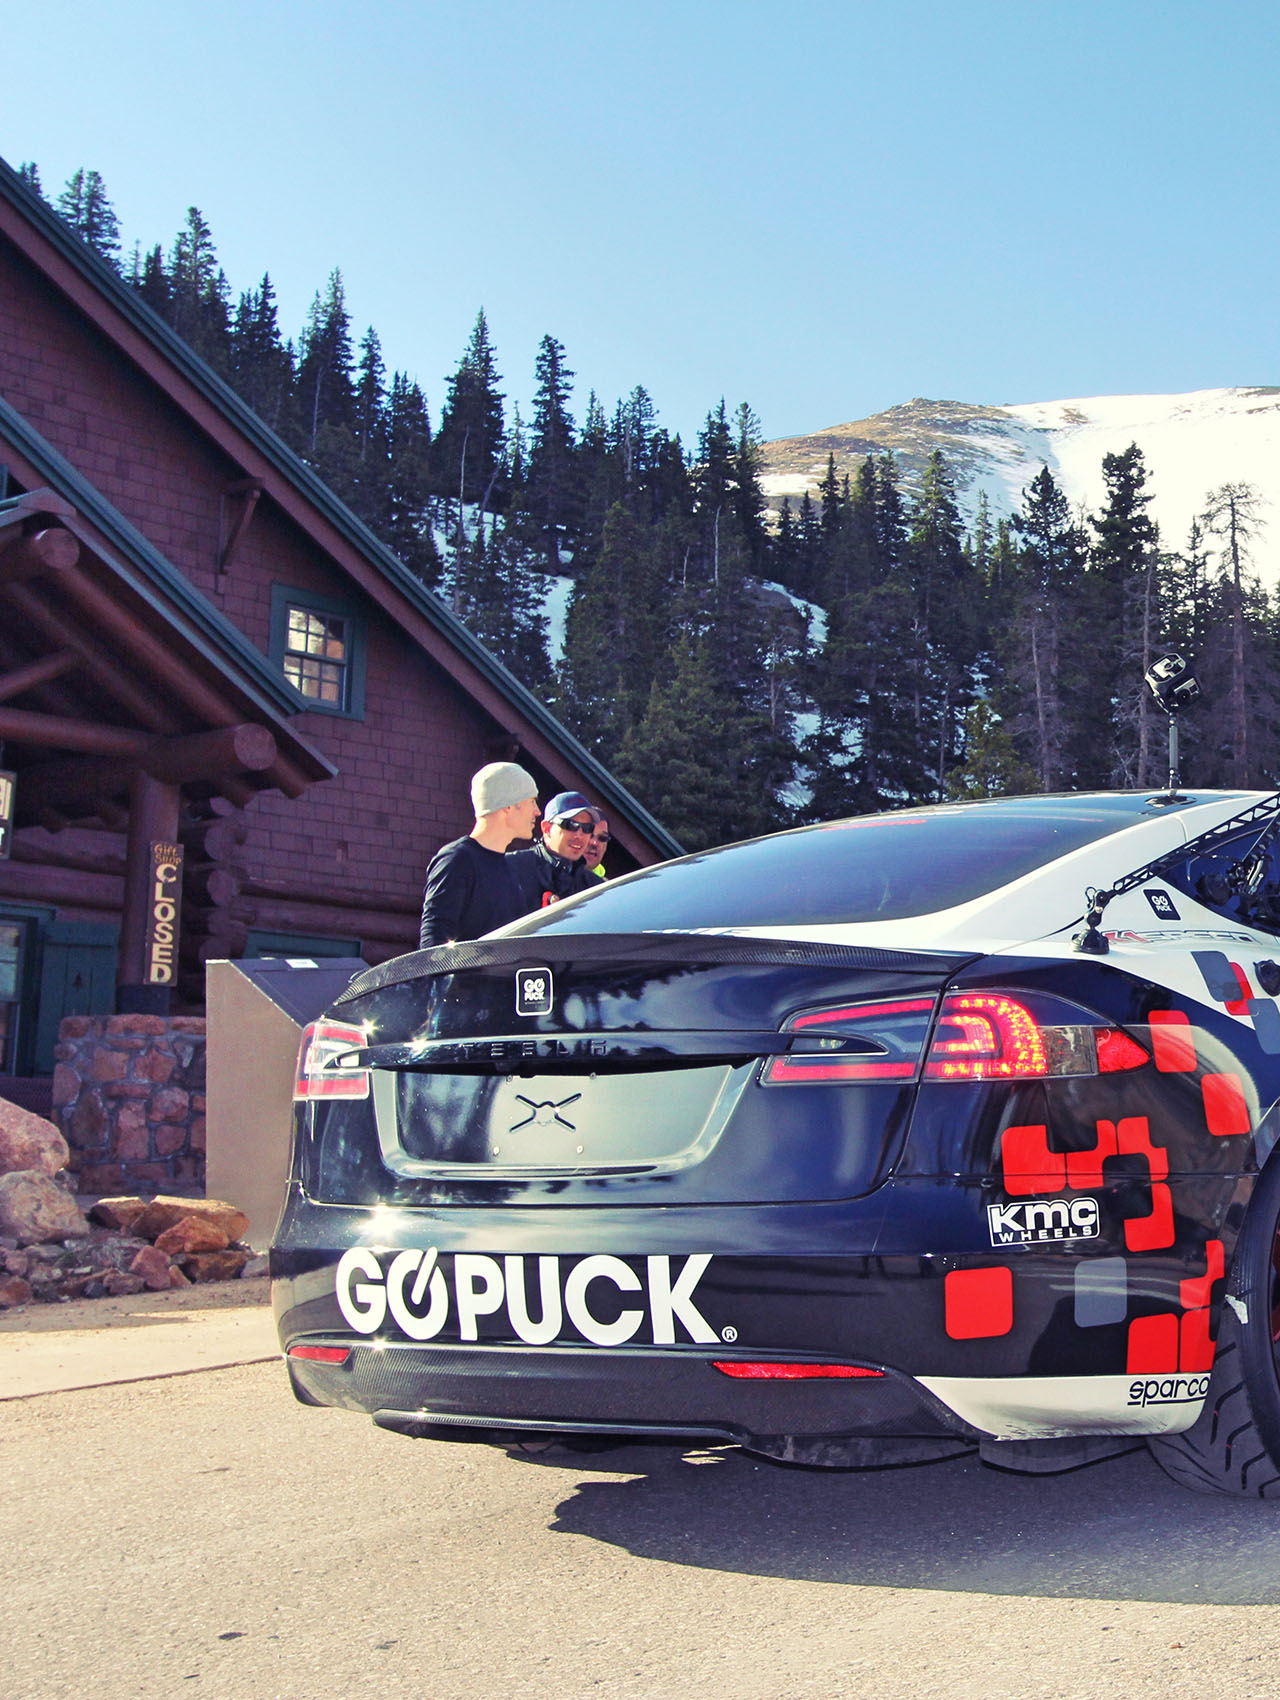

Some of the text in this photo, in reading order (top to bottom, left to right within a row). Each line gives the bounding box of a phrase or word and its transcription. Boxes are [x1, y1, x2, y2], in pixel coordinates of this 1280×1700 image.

[150, 863, 177, 983] CLOSED
[999, 1226, 1092, 1242] WHEELS
[1128, 1377, 1209, 1407] sparco
